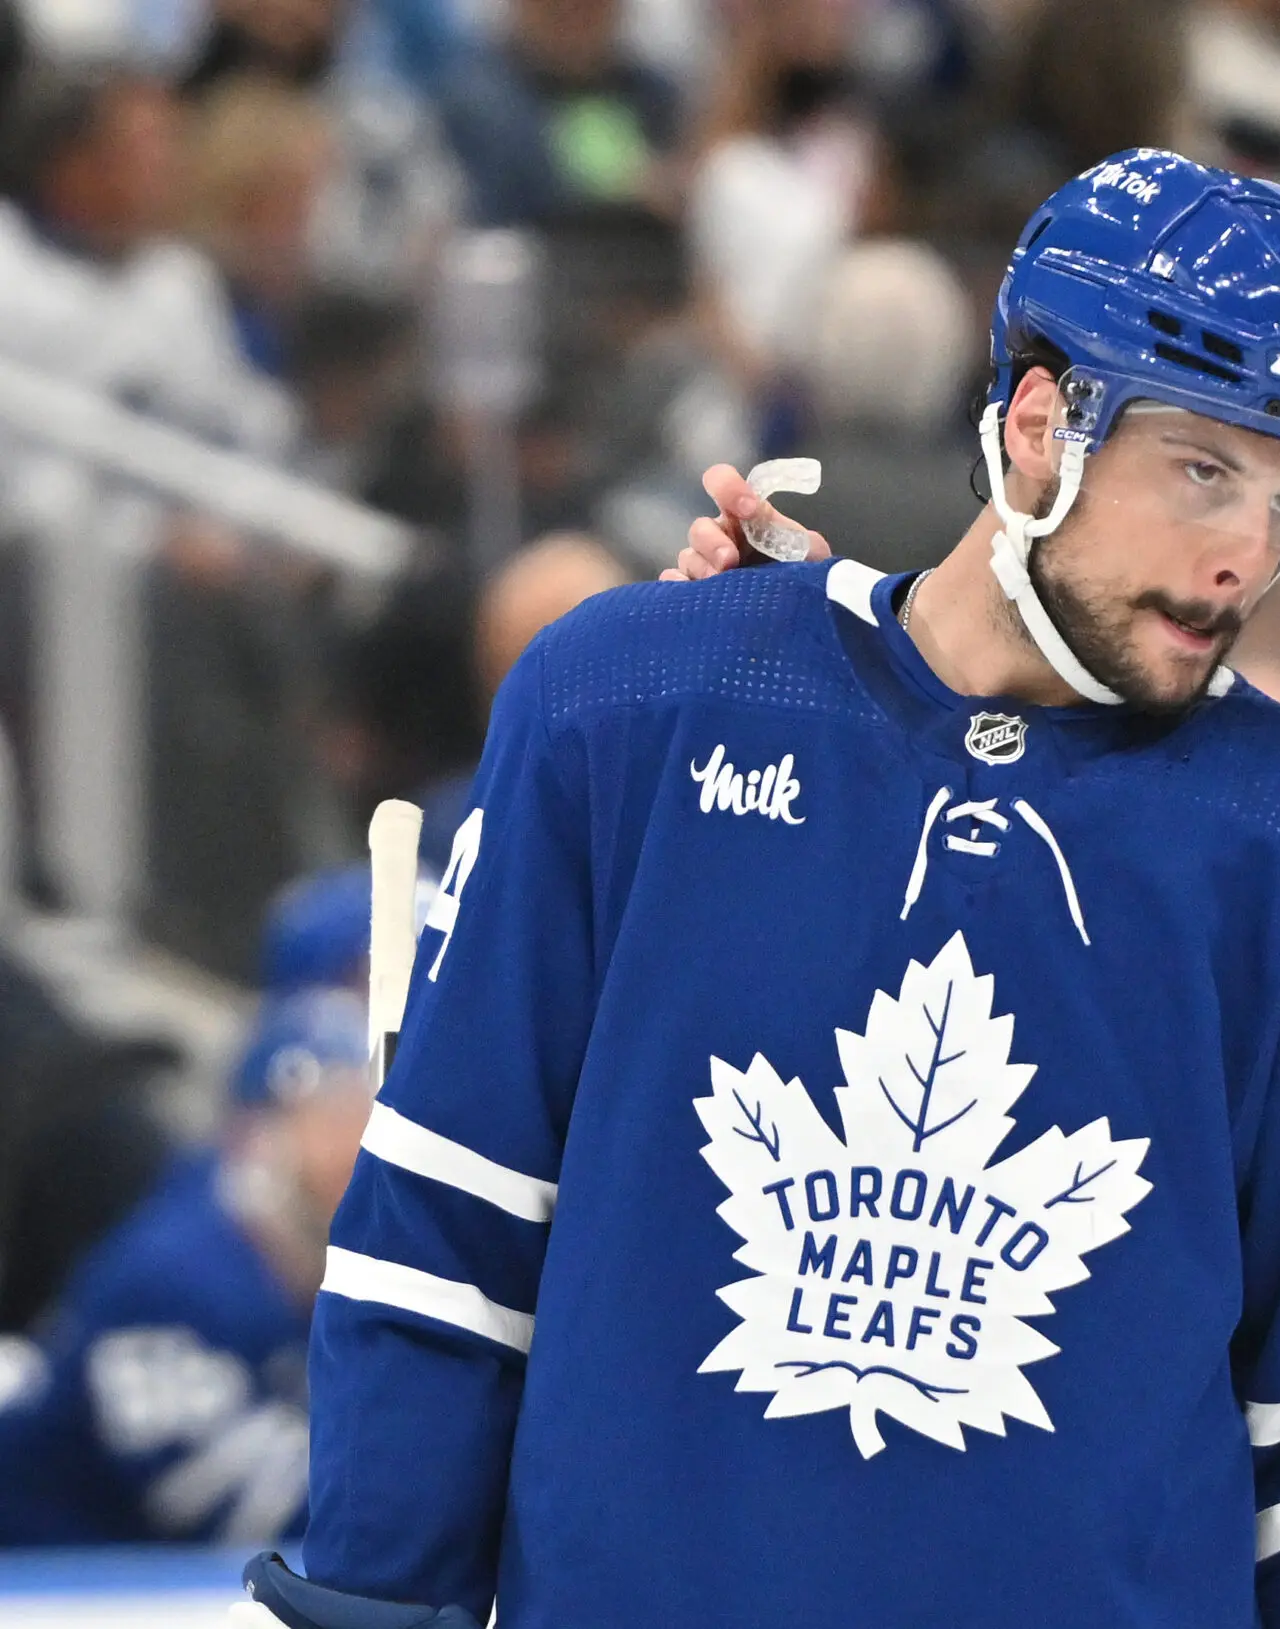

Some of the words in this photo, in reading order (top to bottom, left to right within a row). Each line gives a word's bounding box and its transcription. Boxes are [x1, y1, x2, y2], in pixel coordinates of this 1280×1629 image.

[1054, 429, 1086, 442] CCM
[979, 727, 1015, 749] NHL
[690, 743, 806, 825] Milk
[763, 1166, 1049, 1271] TORONTO
[798, 1231, 994, 1304] MAPLE
[786, 1287, 982, 1360] LEAFS
